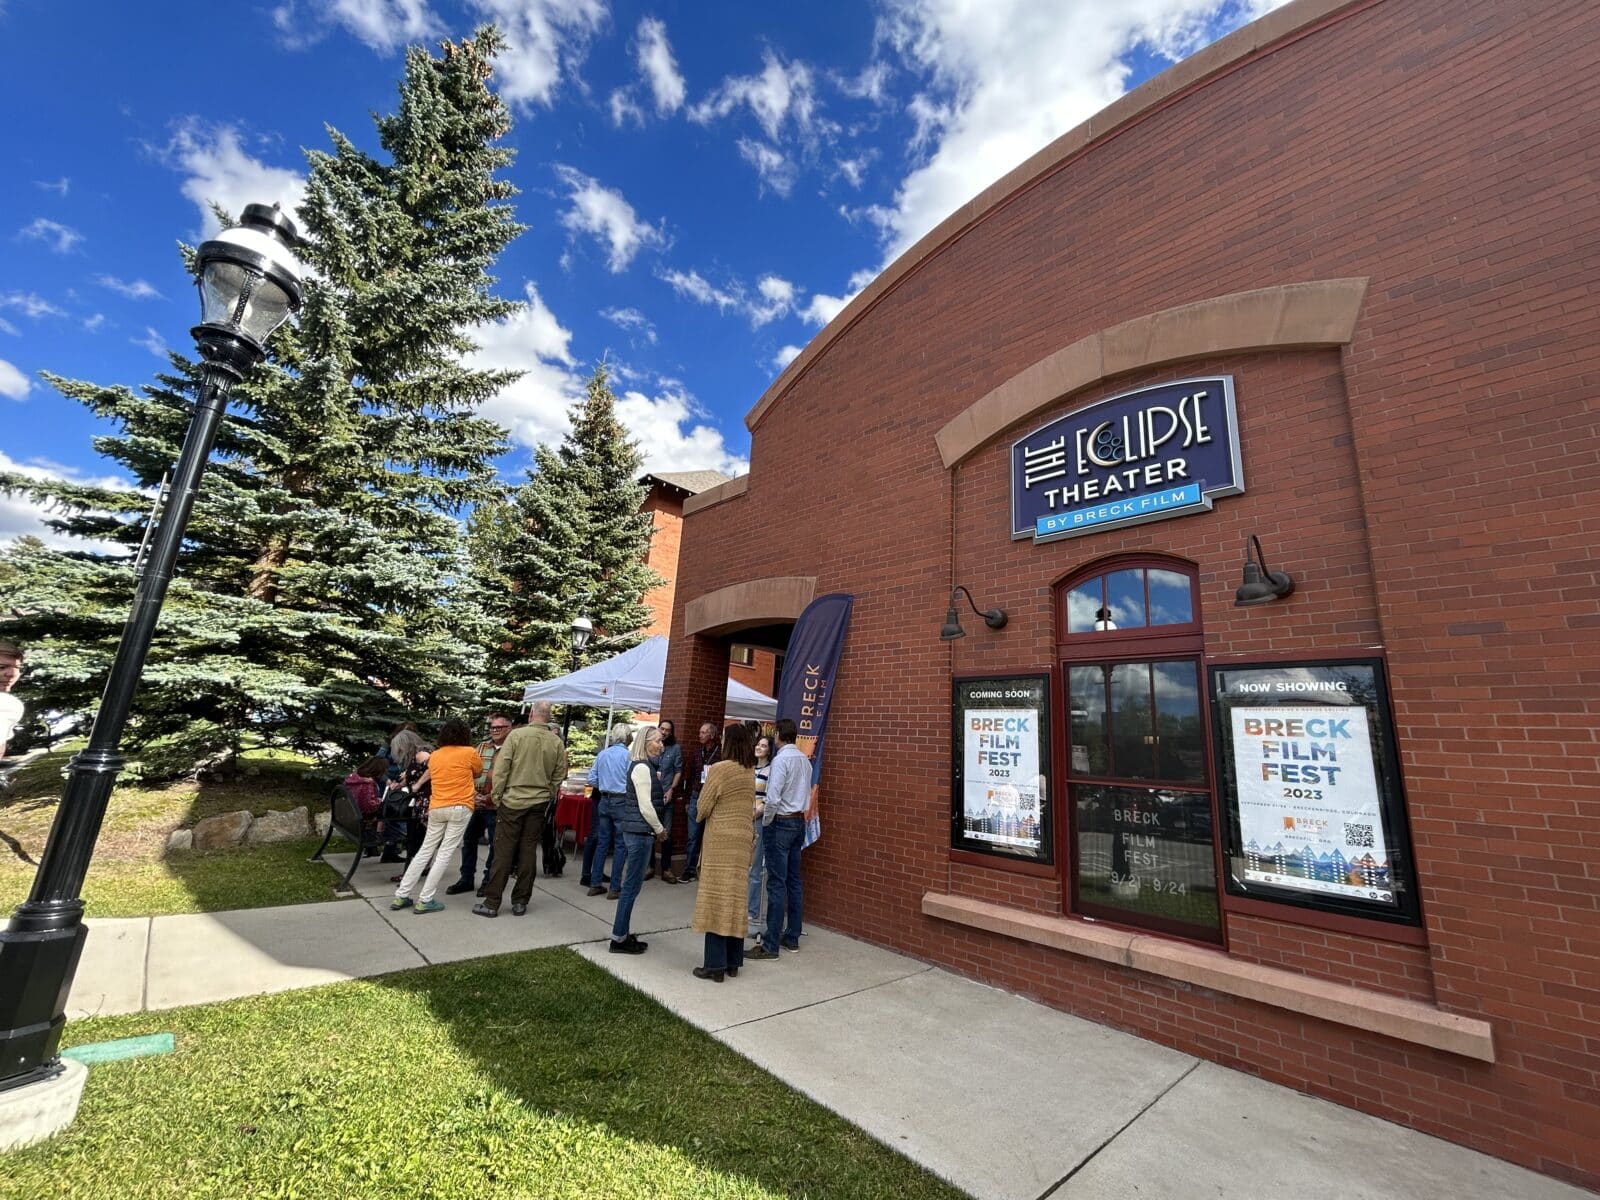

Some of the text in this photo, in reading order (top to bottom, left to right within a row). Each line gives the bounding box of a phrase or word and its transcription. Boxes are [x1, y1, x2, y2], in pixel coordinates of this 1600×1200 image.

[1076, 391, 1212, 475] ECLIPSE
[1024, 435, 1066, 489] THE
[1044, 458, 1188, 508] THEATER
[1047, 491, 1186, 529] BY BRECK FILM
[970, 690, 1030, 699] COMING SOON
[1239, 681, 1347, 693] NOW SHOWING
[800, 664, 820, 730] BRECK
[816, 680, 827, 717] FILM
[971, 718, 1029, 732] BRECK
[1244, 718, 1352, 738] BRECK
[980, 734, 1020, 749] FILM
[978, 751, 1021, 766] FEST
[1262, 741, 1336, 761] FILM
[989, 769, 1010, 777] 2023
[1261, 763, 1341, 785] FEST
[1283, 787, 1323, 800] 2023
[1114, 809, 1160, 825] BRECK
[1296, 817, 1328, 827] BRECK
[1122, 832, 1156, 848] FILM
[1124, 850, 1159, 868] FEST
